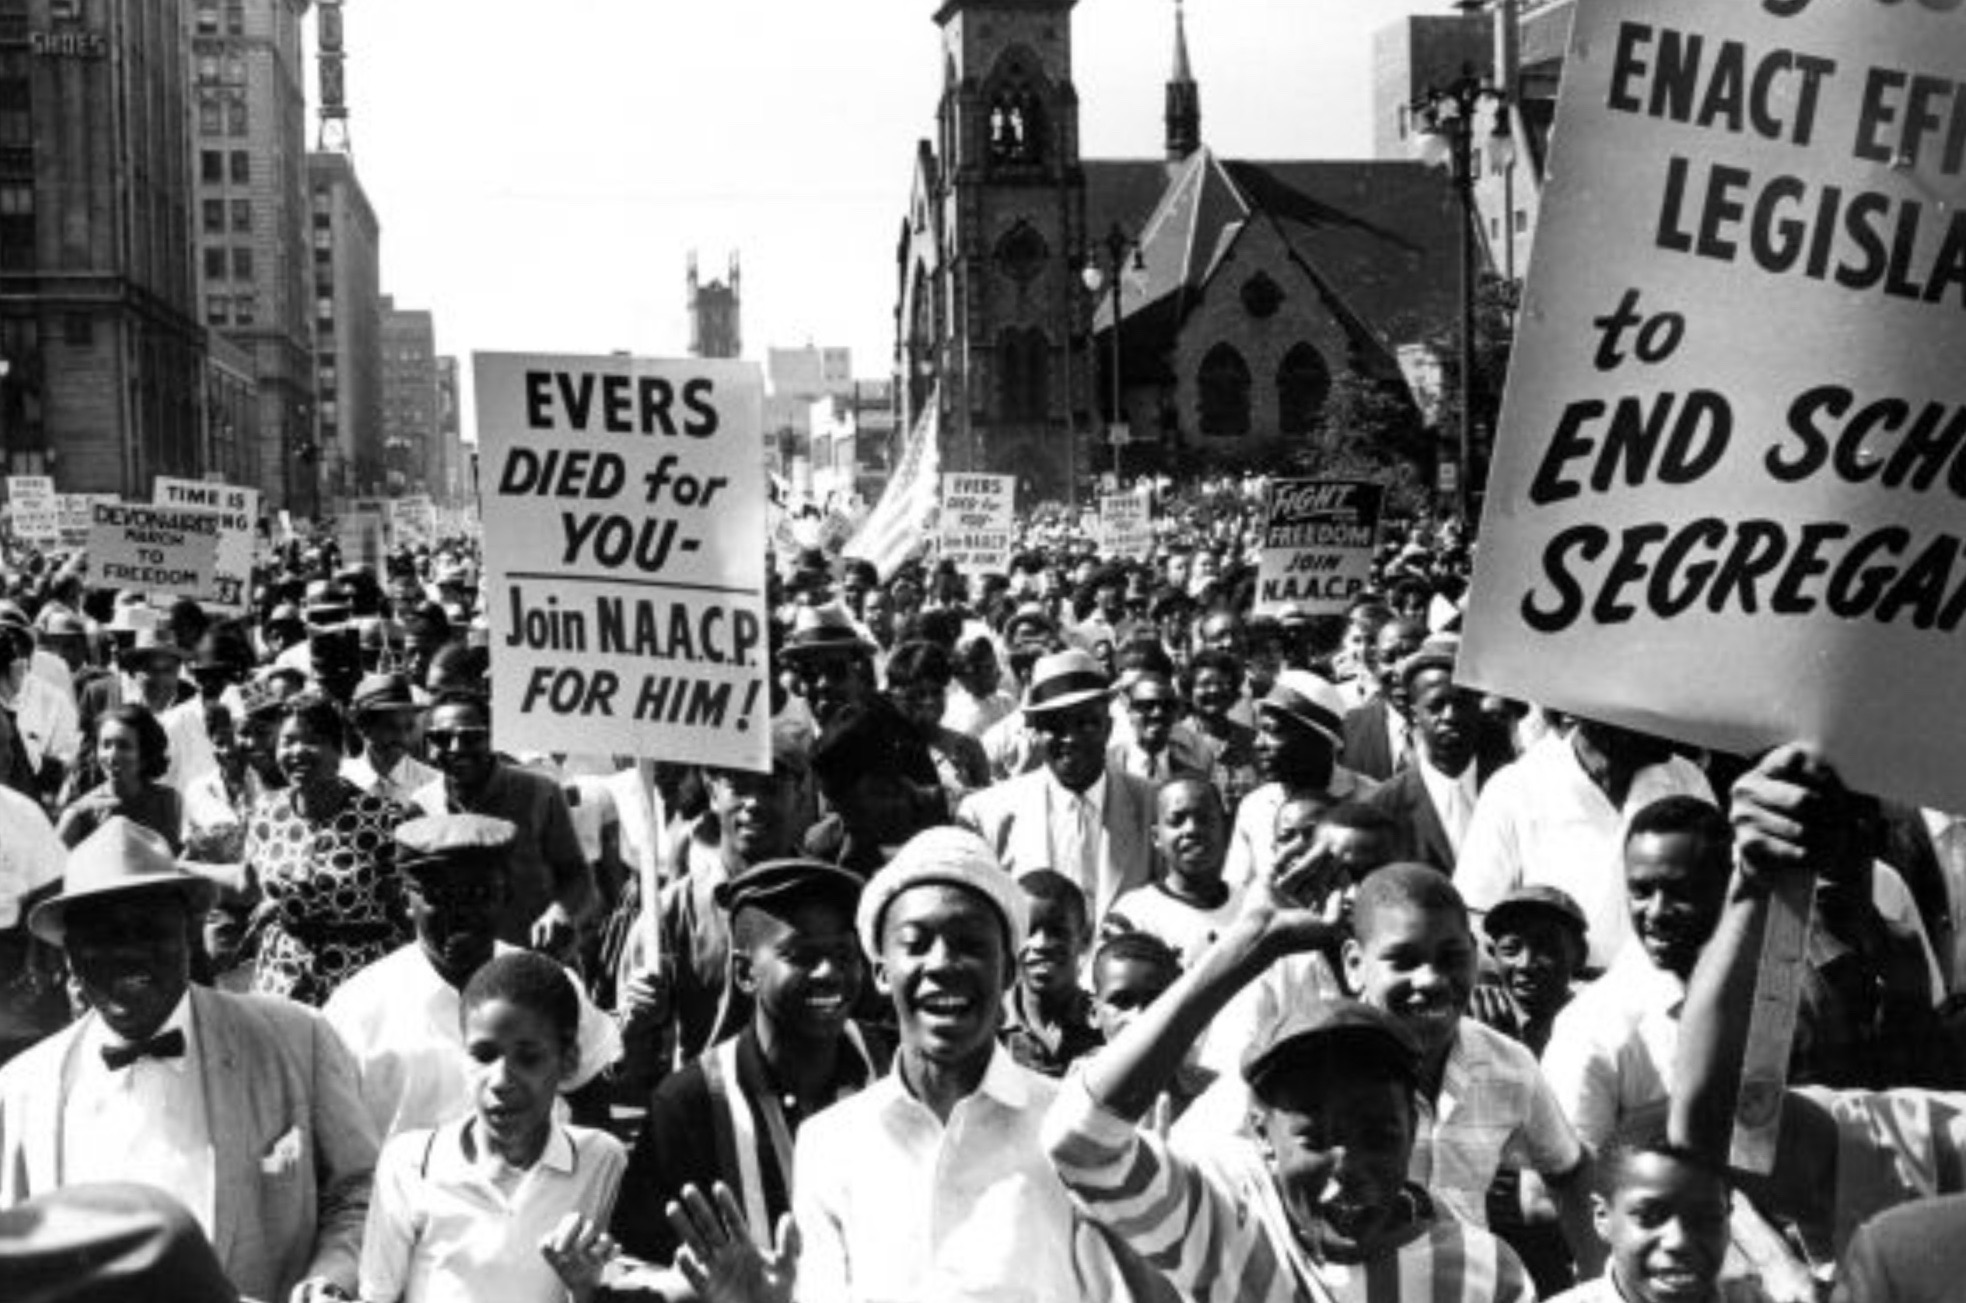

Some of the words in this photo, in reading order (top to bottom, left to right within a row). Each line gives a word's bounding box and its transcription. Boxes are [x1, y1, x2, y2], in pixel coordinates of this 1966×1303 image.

[1607, 21, 1836, 147] ENACT
[1656, 156, 1966, 312] LEGISLA
[1593, 288, 1686, 371] to
[525, 370, 719, 438] EVERS
[499, 447, 627, 500] DIED
[643, 454, 729, 509] for
[1529, 389, 1733, 505] END
[167, 486, 220, 506] TIME
[228, 492, 245, 511] IS
[137, 549, 164, 564] TO
[561, 511, 702, 573] YOU-
[506, 586, 586, 653] Join
[521, 667, 620, 717] FOR
